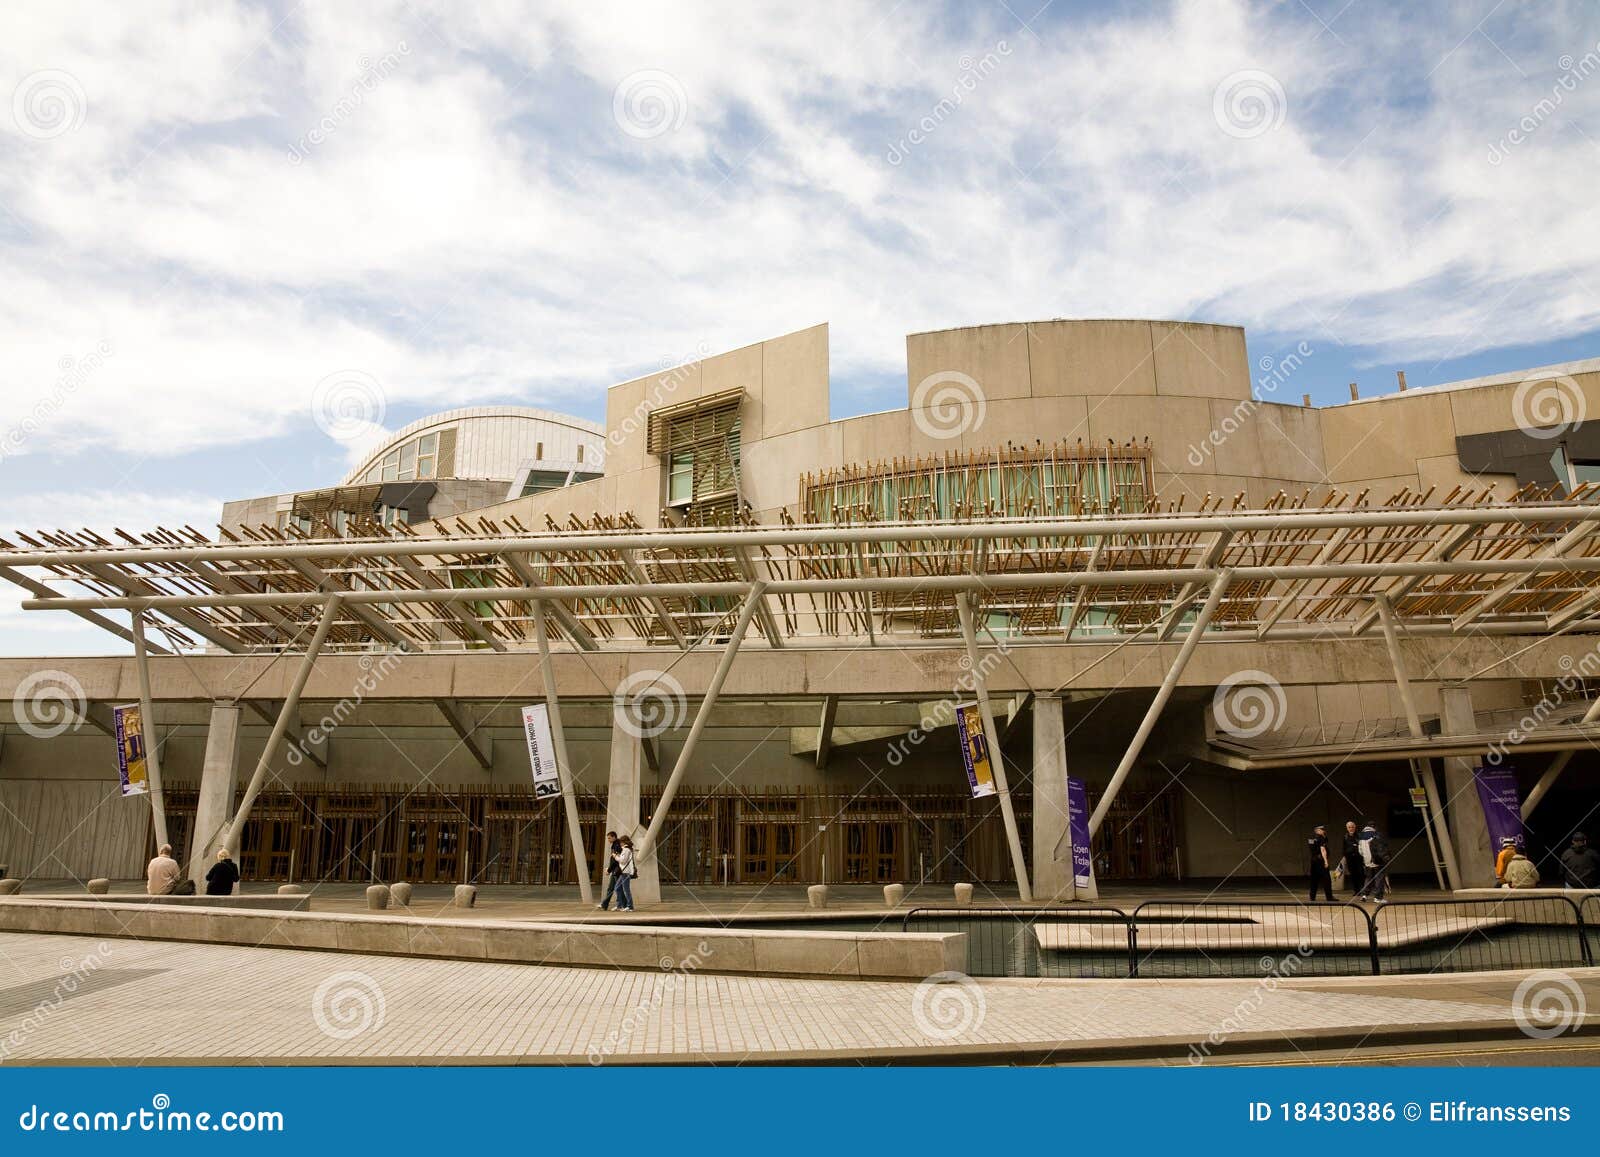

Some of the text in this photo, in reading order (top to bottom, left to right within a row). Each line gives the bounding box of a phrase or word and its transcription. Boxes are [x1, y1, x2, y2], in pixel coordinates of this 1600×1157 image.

[528, 722, 537, 741] PHOTO
[530, 740, 539, 756] PRESS
[533, 755, 542, 776] WORLD
